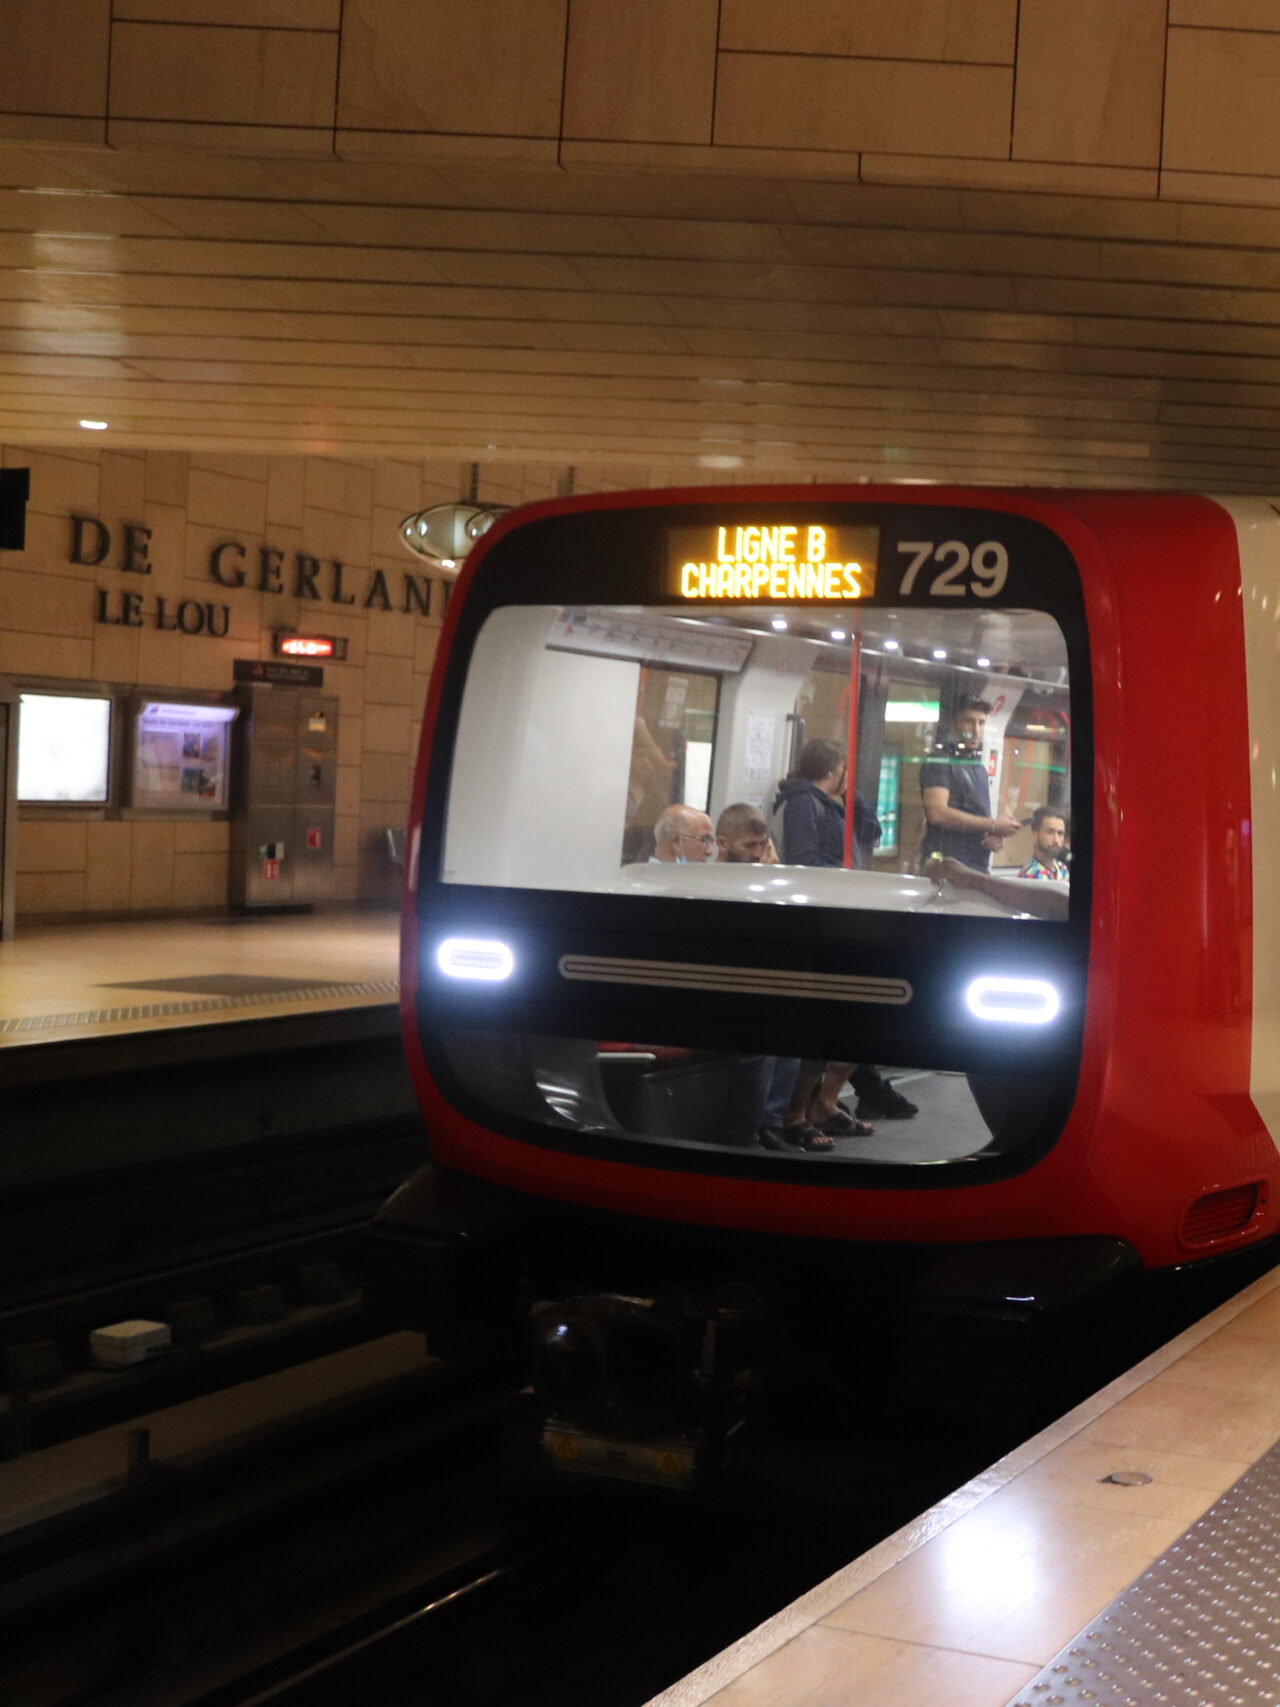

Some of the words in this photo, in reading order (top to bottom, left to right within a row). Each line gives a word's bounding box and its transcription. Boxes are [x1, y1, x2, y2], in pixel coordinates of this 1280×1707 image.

[69, 514, 152, 575] DE
[717, 525, 797, 563] LIGNE
[806, 526, 826, 563] B
[681, 563, 862, 599] CHARPENNES
[896, 541, 1008, 599] 729
[97, 589, 144, 628] LE
[155, 596, 231, 638] LOU
